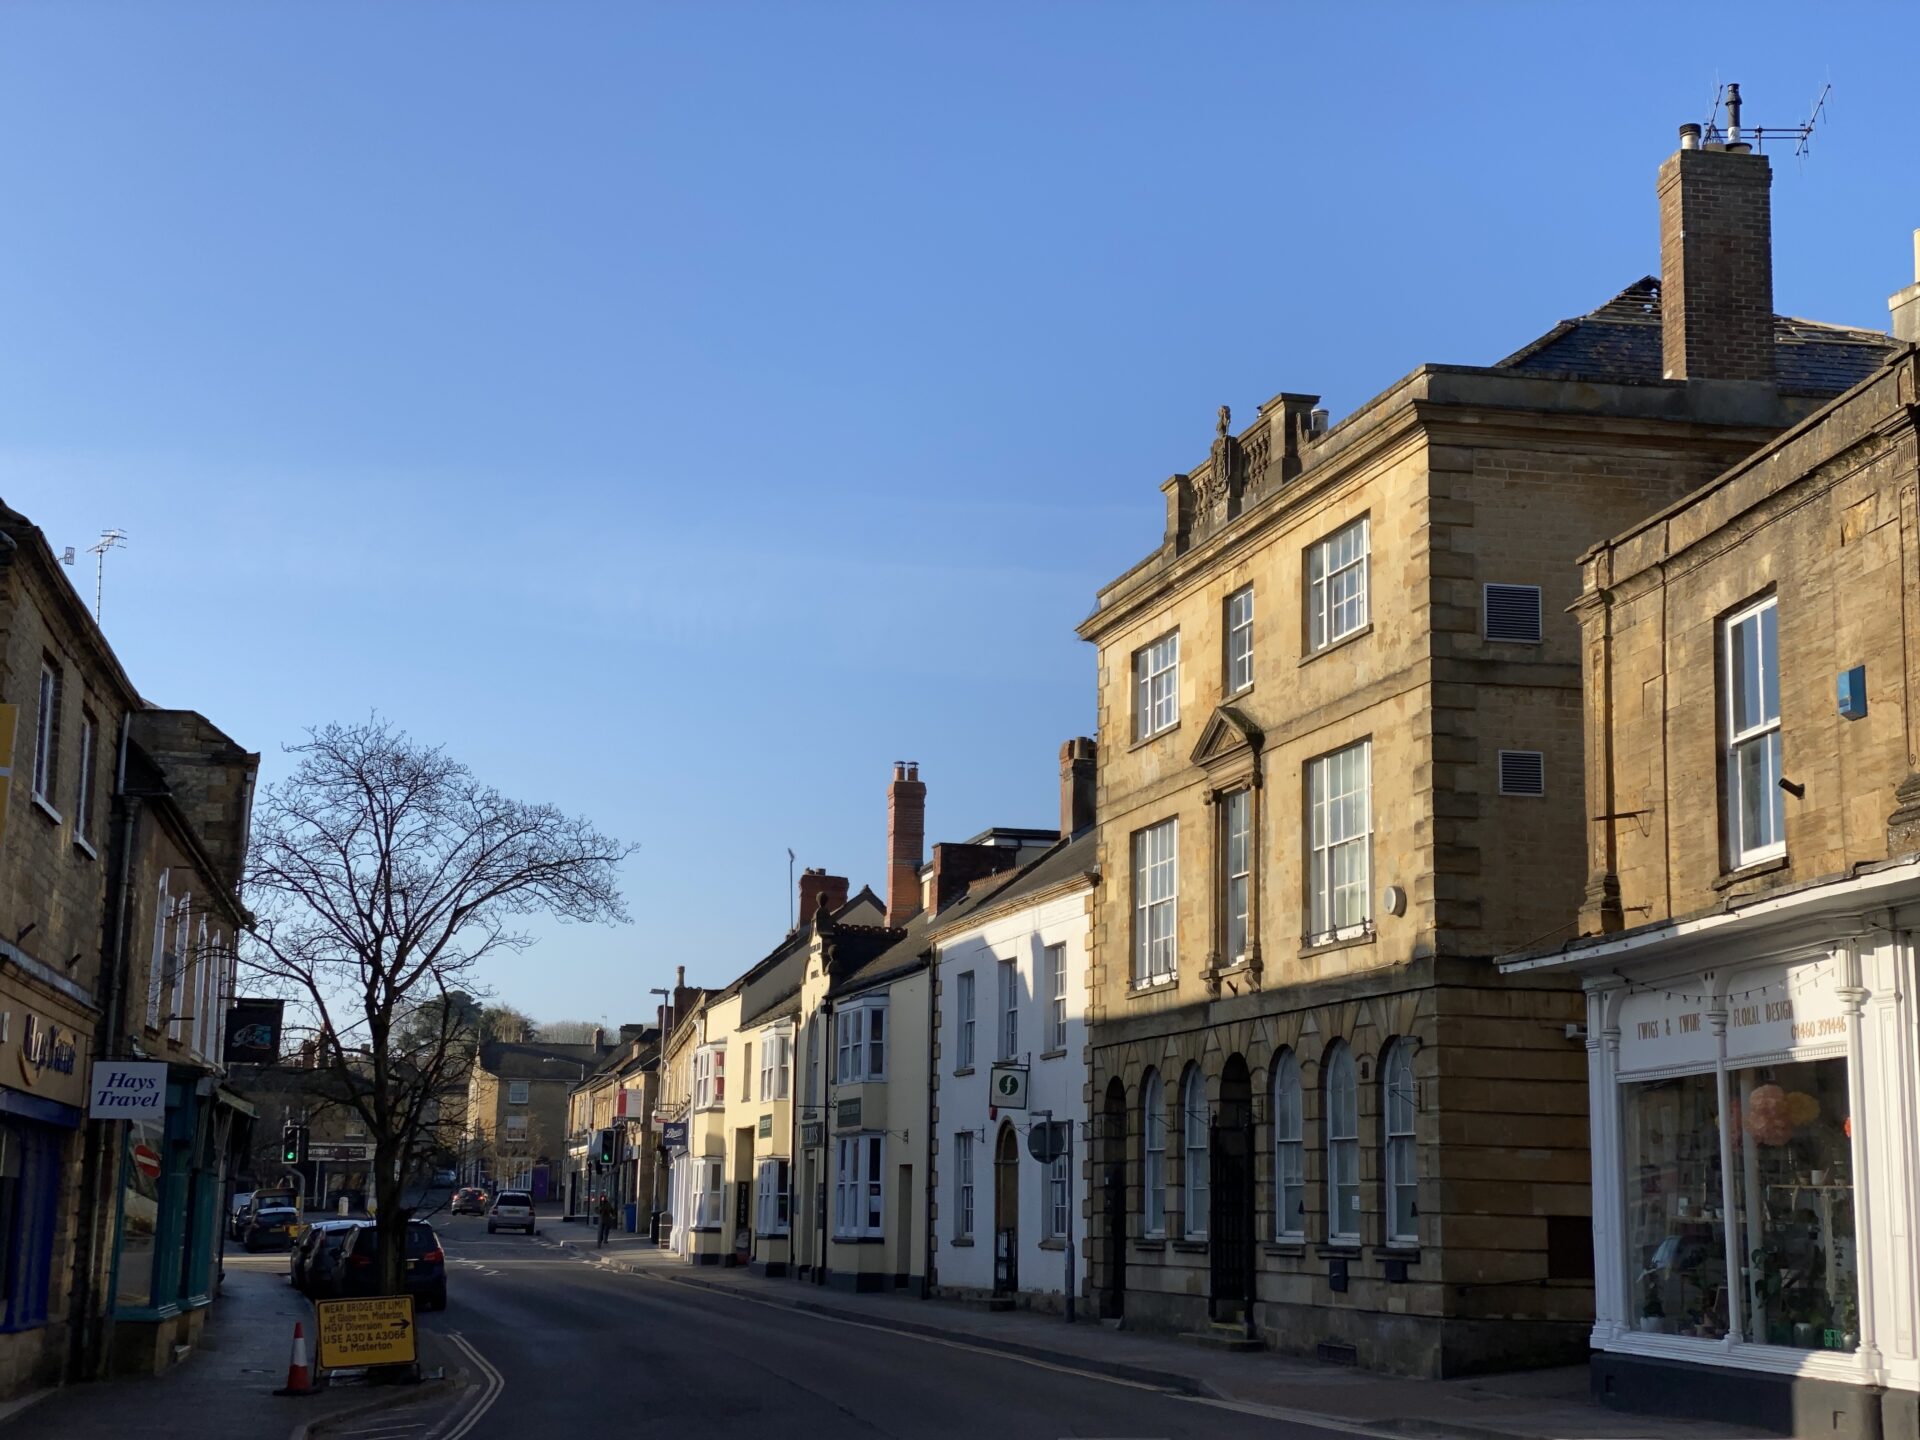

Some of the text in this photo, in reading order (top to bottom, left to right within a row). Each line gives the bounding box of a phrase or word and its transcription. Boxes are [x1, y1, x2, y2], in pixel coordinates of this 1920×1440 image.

[1637, 1000, 1794, 1040] TWIGS & TWINE FLORAL DESIGN
[1791, 1021, 1815, 1040] 01460
[106, 1072, 156, 1092] Hays
[98, 1091, 160, 1107] Travel
[324, 1304, 344, 1314] WEAK
[346, 1302, 373, 1312] BRIDGE
[388, 1300, 407, 1310] LIMIT
[324, 1322, 382, 1333] HGV Diversion
[323, 1334, 343, 1344] USE
[346, 1332, 365, 1343] A30
[367, 1333, 373, 1341] &
[339, 1342, 392, 1353] to Misterton
